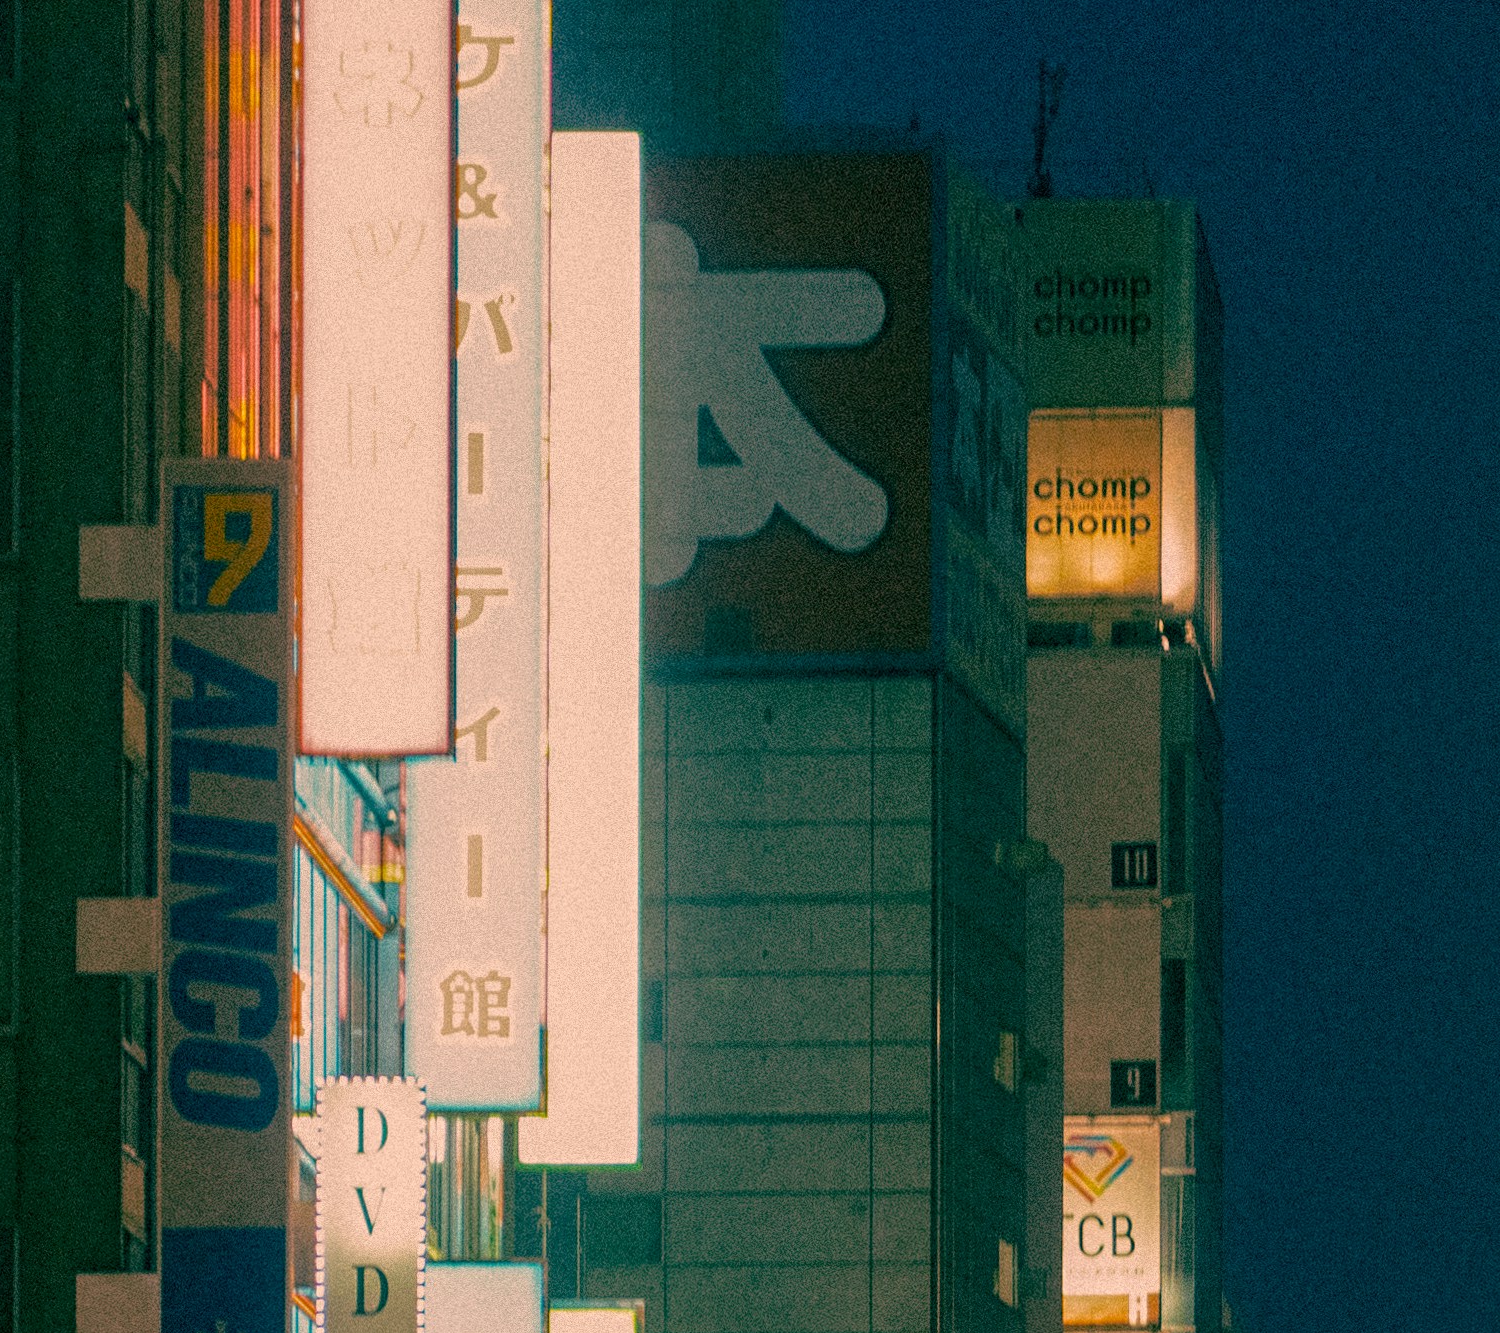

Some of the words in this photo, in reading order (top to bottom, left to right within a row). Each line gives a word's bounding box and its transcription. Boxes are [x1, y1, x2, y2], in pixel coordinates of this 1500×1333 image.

[1033, 271, 1152, 310] chomp
[1033, 306, 1152, 345] chomp
[1033, 467, 1151, 511] chomp
[1033, 502, 1151, 544] chomp
[170, 635, 279, 1133] ALINCO
[1064, 1213, 1135, 1258] CB
